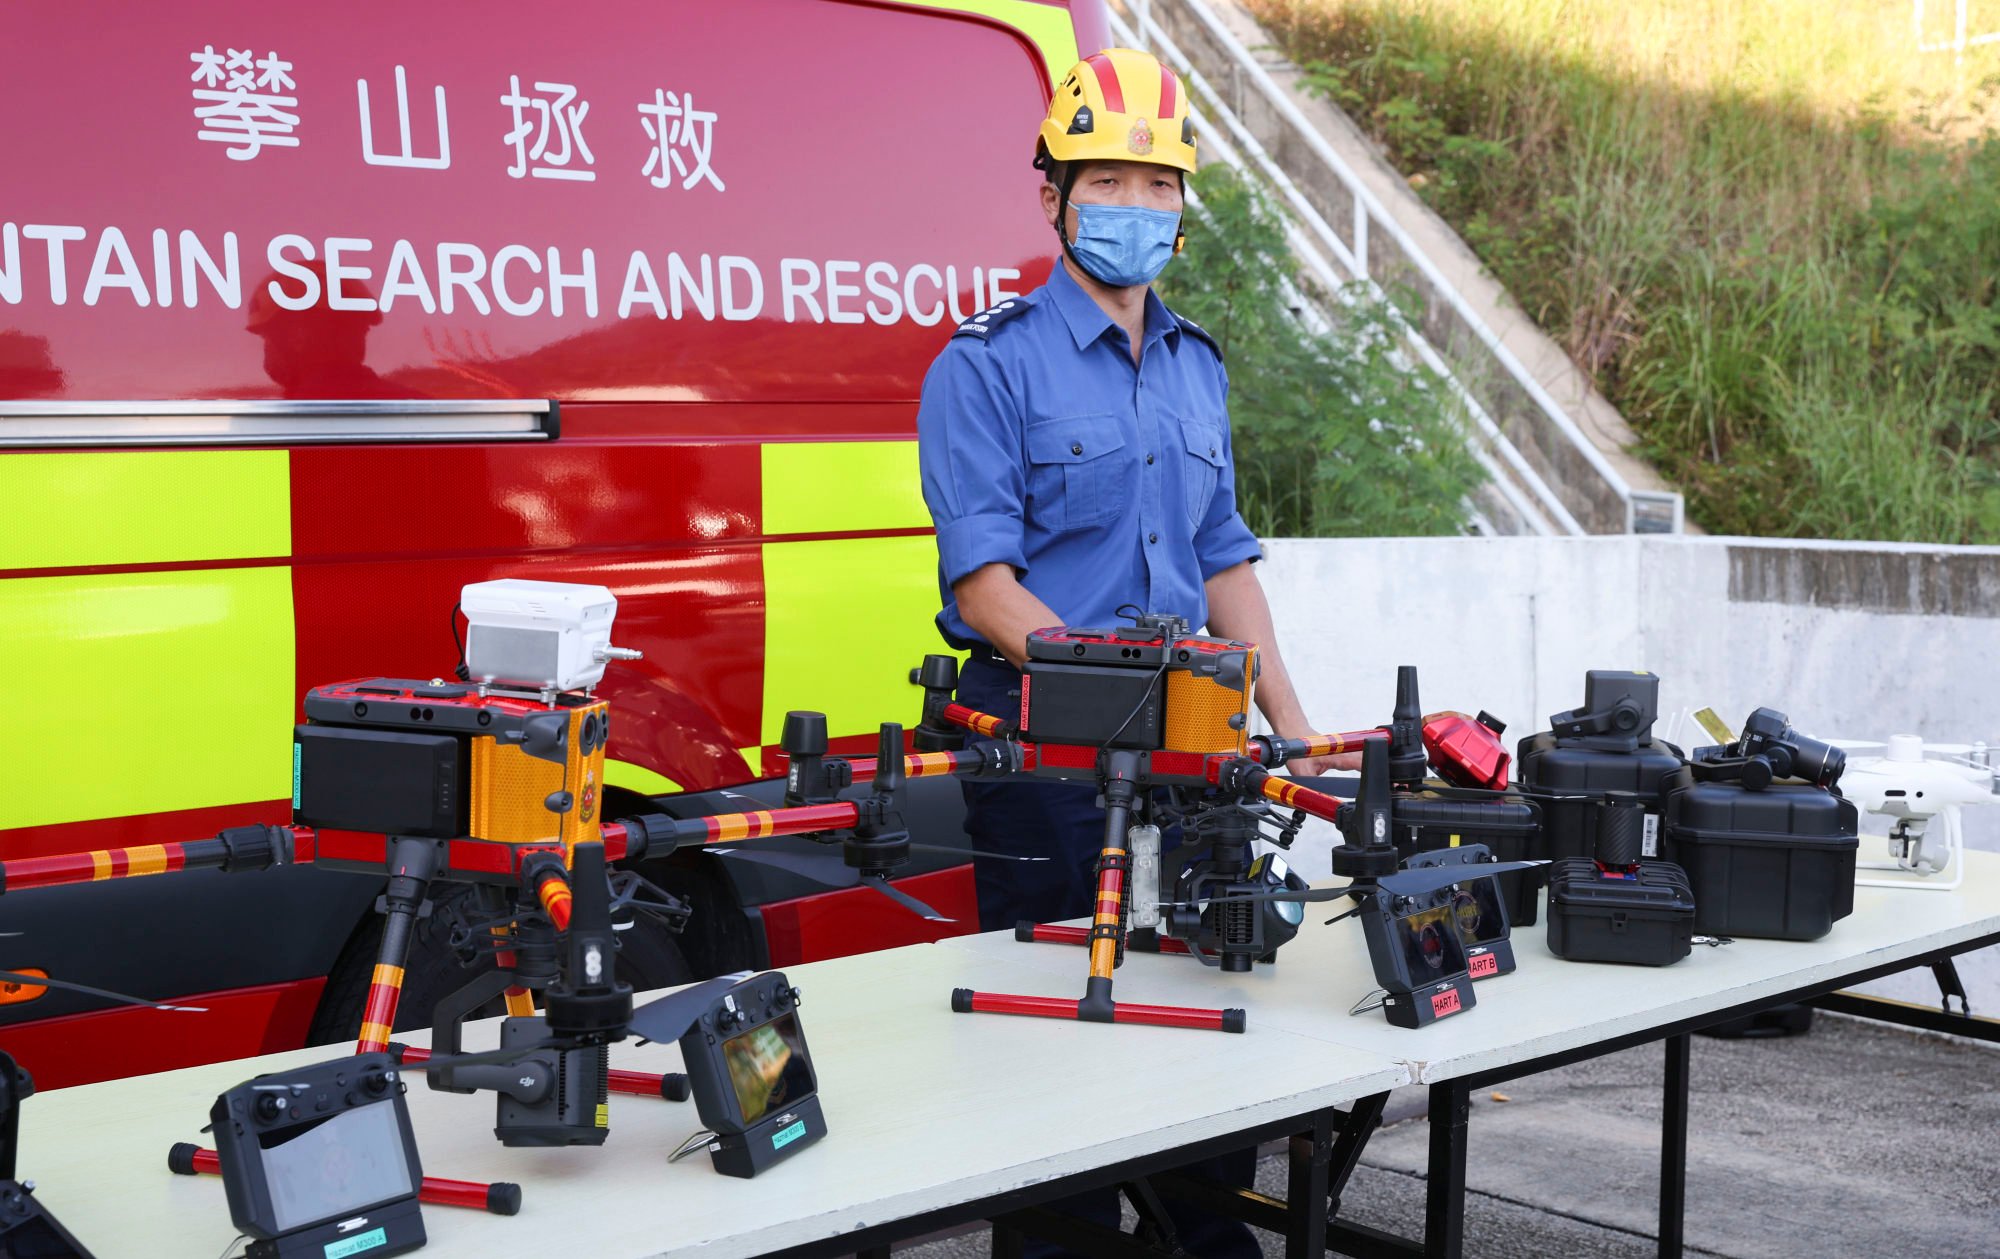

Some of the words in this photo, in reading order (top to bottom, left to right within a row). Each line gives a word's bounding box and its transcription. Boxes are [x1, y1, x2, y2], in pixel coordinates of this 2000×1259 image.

[190, 45, 725, 192] 攀山拯救
[267, 234, 599, 318] SEARCH
[618, 250, 764, 321] AND
[1489, 958, 1496, 969] B
[1434, 996, 1452, 1013] HART
[1453, 994, 1460, 1006] A
